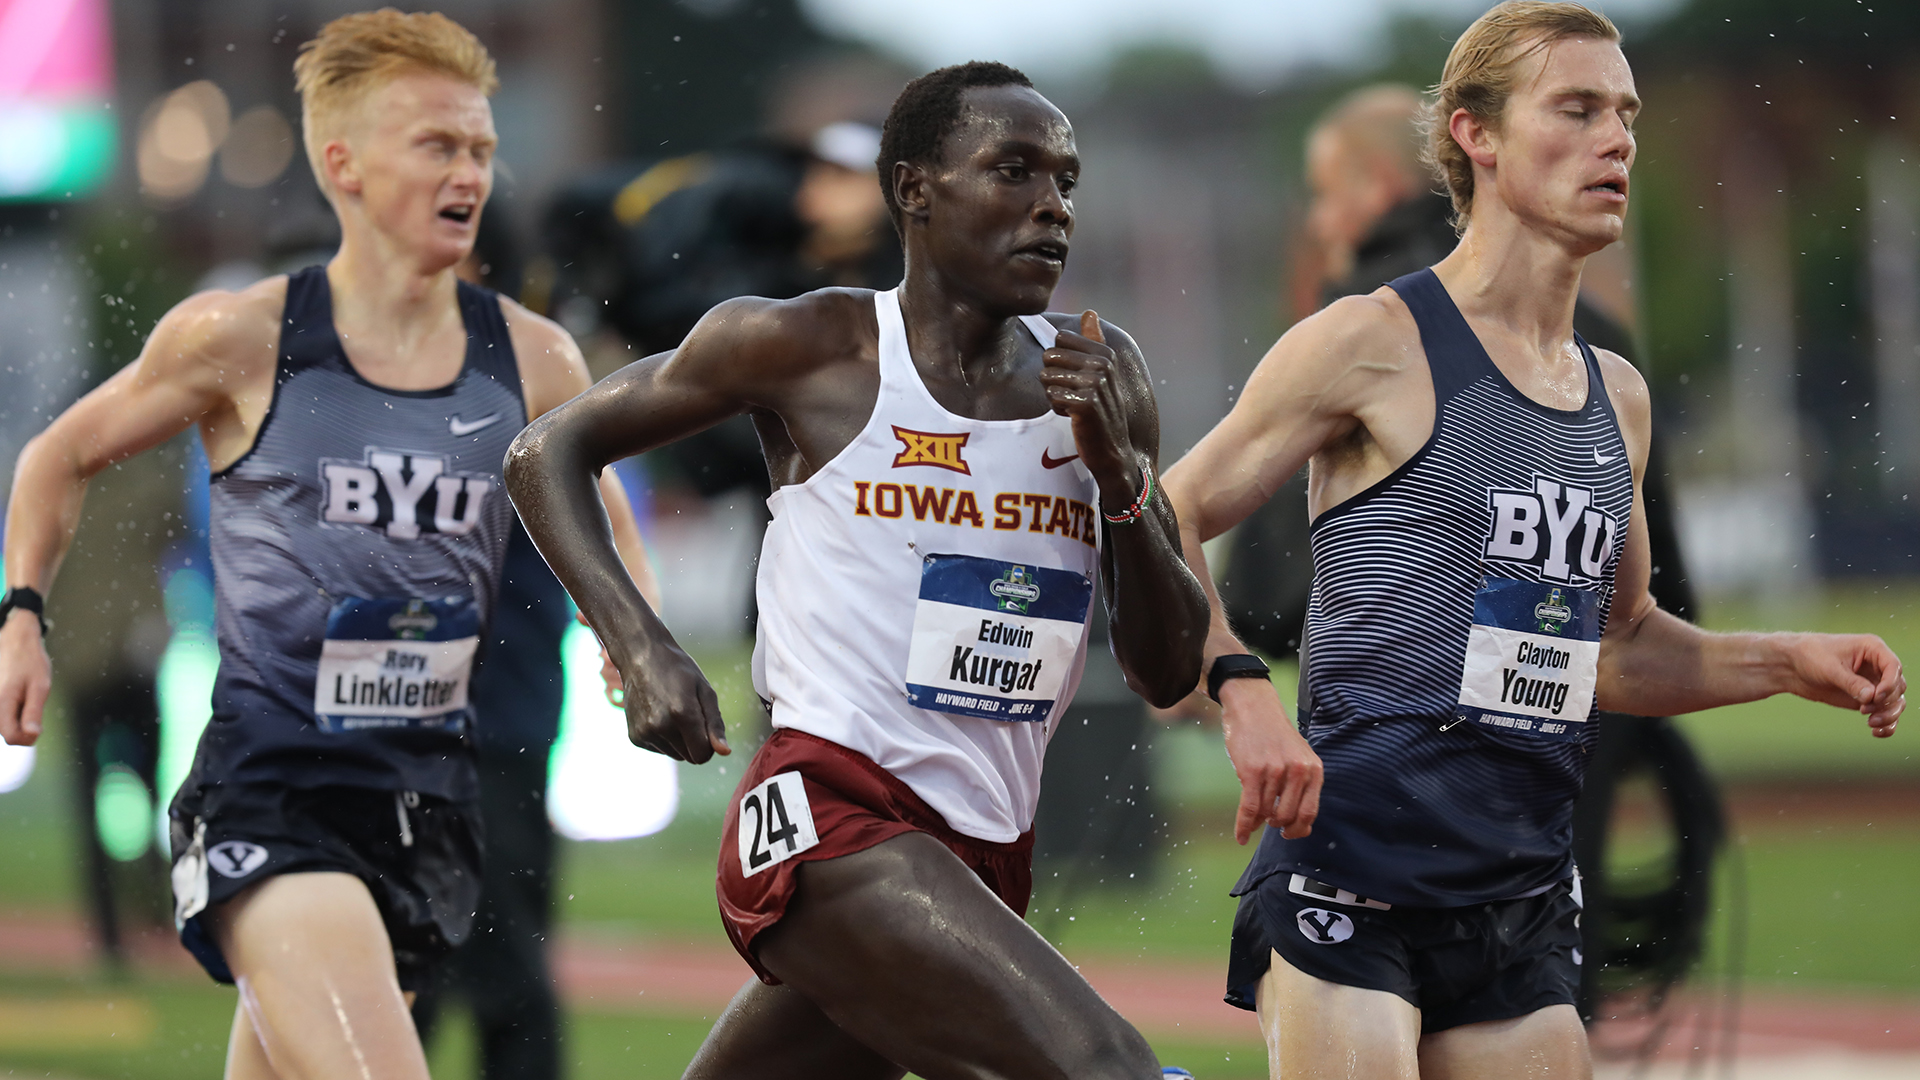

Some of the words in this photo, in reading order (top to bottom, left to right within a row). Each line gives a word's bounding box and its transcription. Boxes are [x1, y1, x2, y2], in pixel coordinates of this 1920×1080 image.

[894, 427, 969, 474] XII
[323, 450, 491, 540] BYU
[853, 480, 985, 529] IOWA
[993, 491, 1097, 549] STATE
[1485, 476, 1617, 581] BYU
[978, 618, 1034, 649] Edwin
[384, 649, 427, 672] Rory
[949, 644, 1043, 693] Kurgat
[1516, 641, 1571, 670] Clayton
[333, 673, 457, 708] Linkletter
[935, 692, 978, 710] HAYWARD
[977, 699, 1000, 712] FIELD
[1008, 703, 1024, 714] JUNE
[1022, 704, 1035, 714] 6-9
[1500, 668, 1570, 715] Young
[1479, 713, 1515, 728] HAYWARD
[1514, 719, 1532, 729] FIELD
[1538, 721, 1556, 733] JUNE
[744, 781, 799, 870] 24
[219, 846, 256, 872] Y
[1300, 910, 1343, 941] Y
